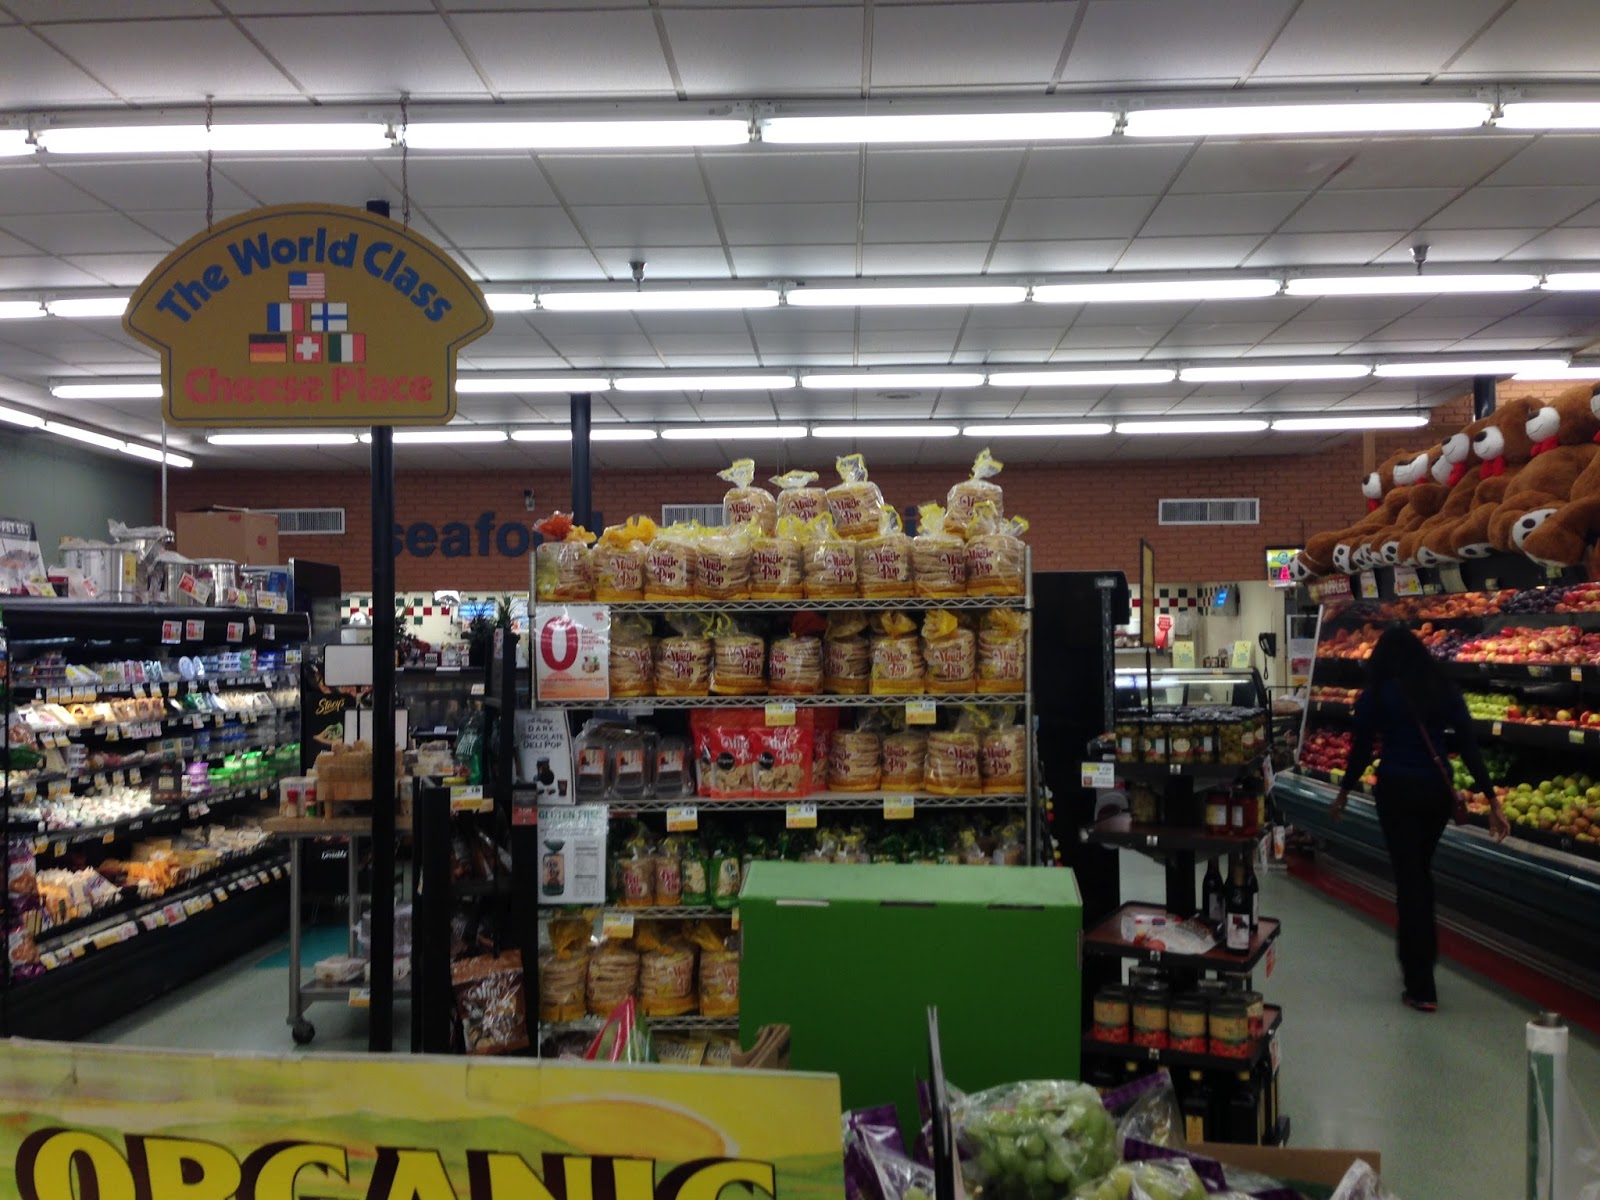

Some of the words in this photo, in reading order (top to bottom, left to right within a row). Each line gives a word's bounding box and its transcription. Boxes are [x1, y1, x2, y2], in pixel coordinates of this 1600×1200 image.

[155, 264, 230, 322] The
[227, 228, 358, 276] World
[363, 241, 452, 322] Class
[183, 367, 325, 404] Cheese
[331, 367, 433, 403] Place
[394, 511, 604, 557] eafo
[653, 568, 676, 582] Pop
[704, 571, 724, 586] Pop
[760, 566, 781, 580] Pop
[878, 565, 900, 579] Pop
[1324, 577, 1348, 595] APPLES
[315, 697, 346, 716] Stacy's
[528, 725, 555, 733] DARK
[523, 740, 543, 749] DELI
[544, 741, 562, 749] POP
